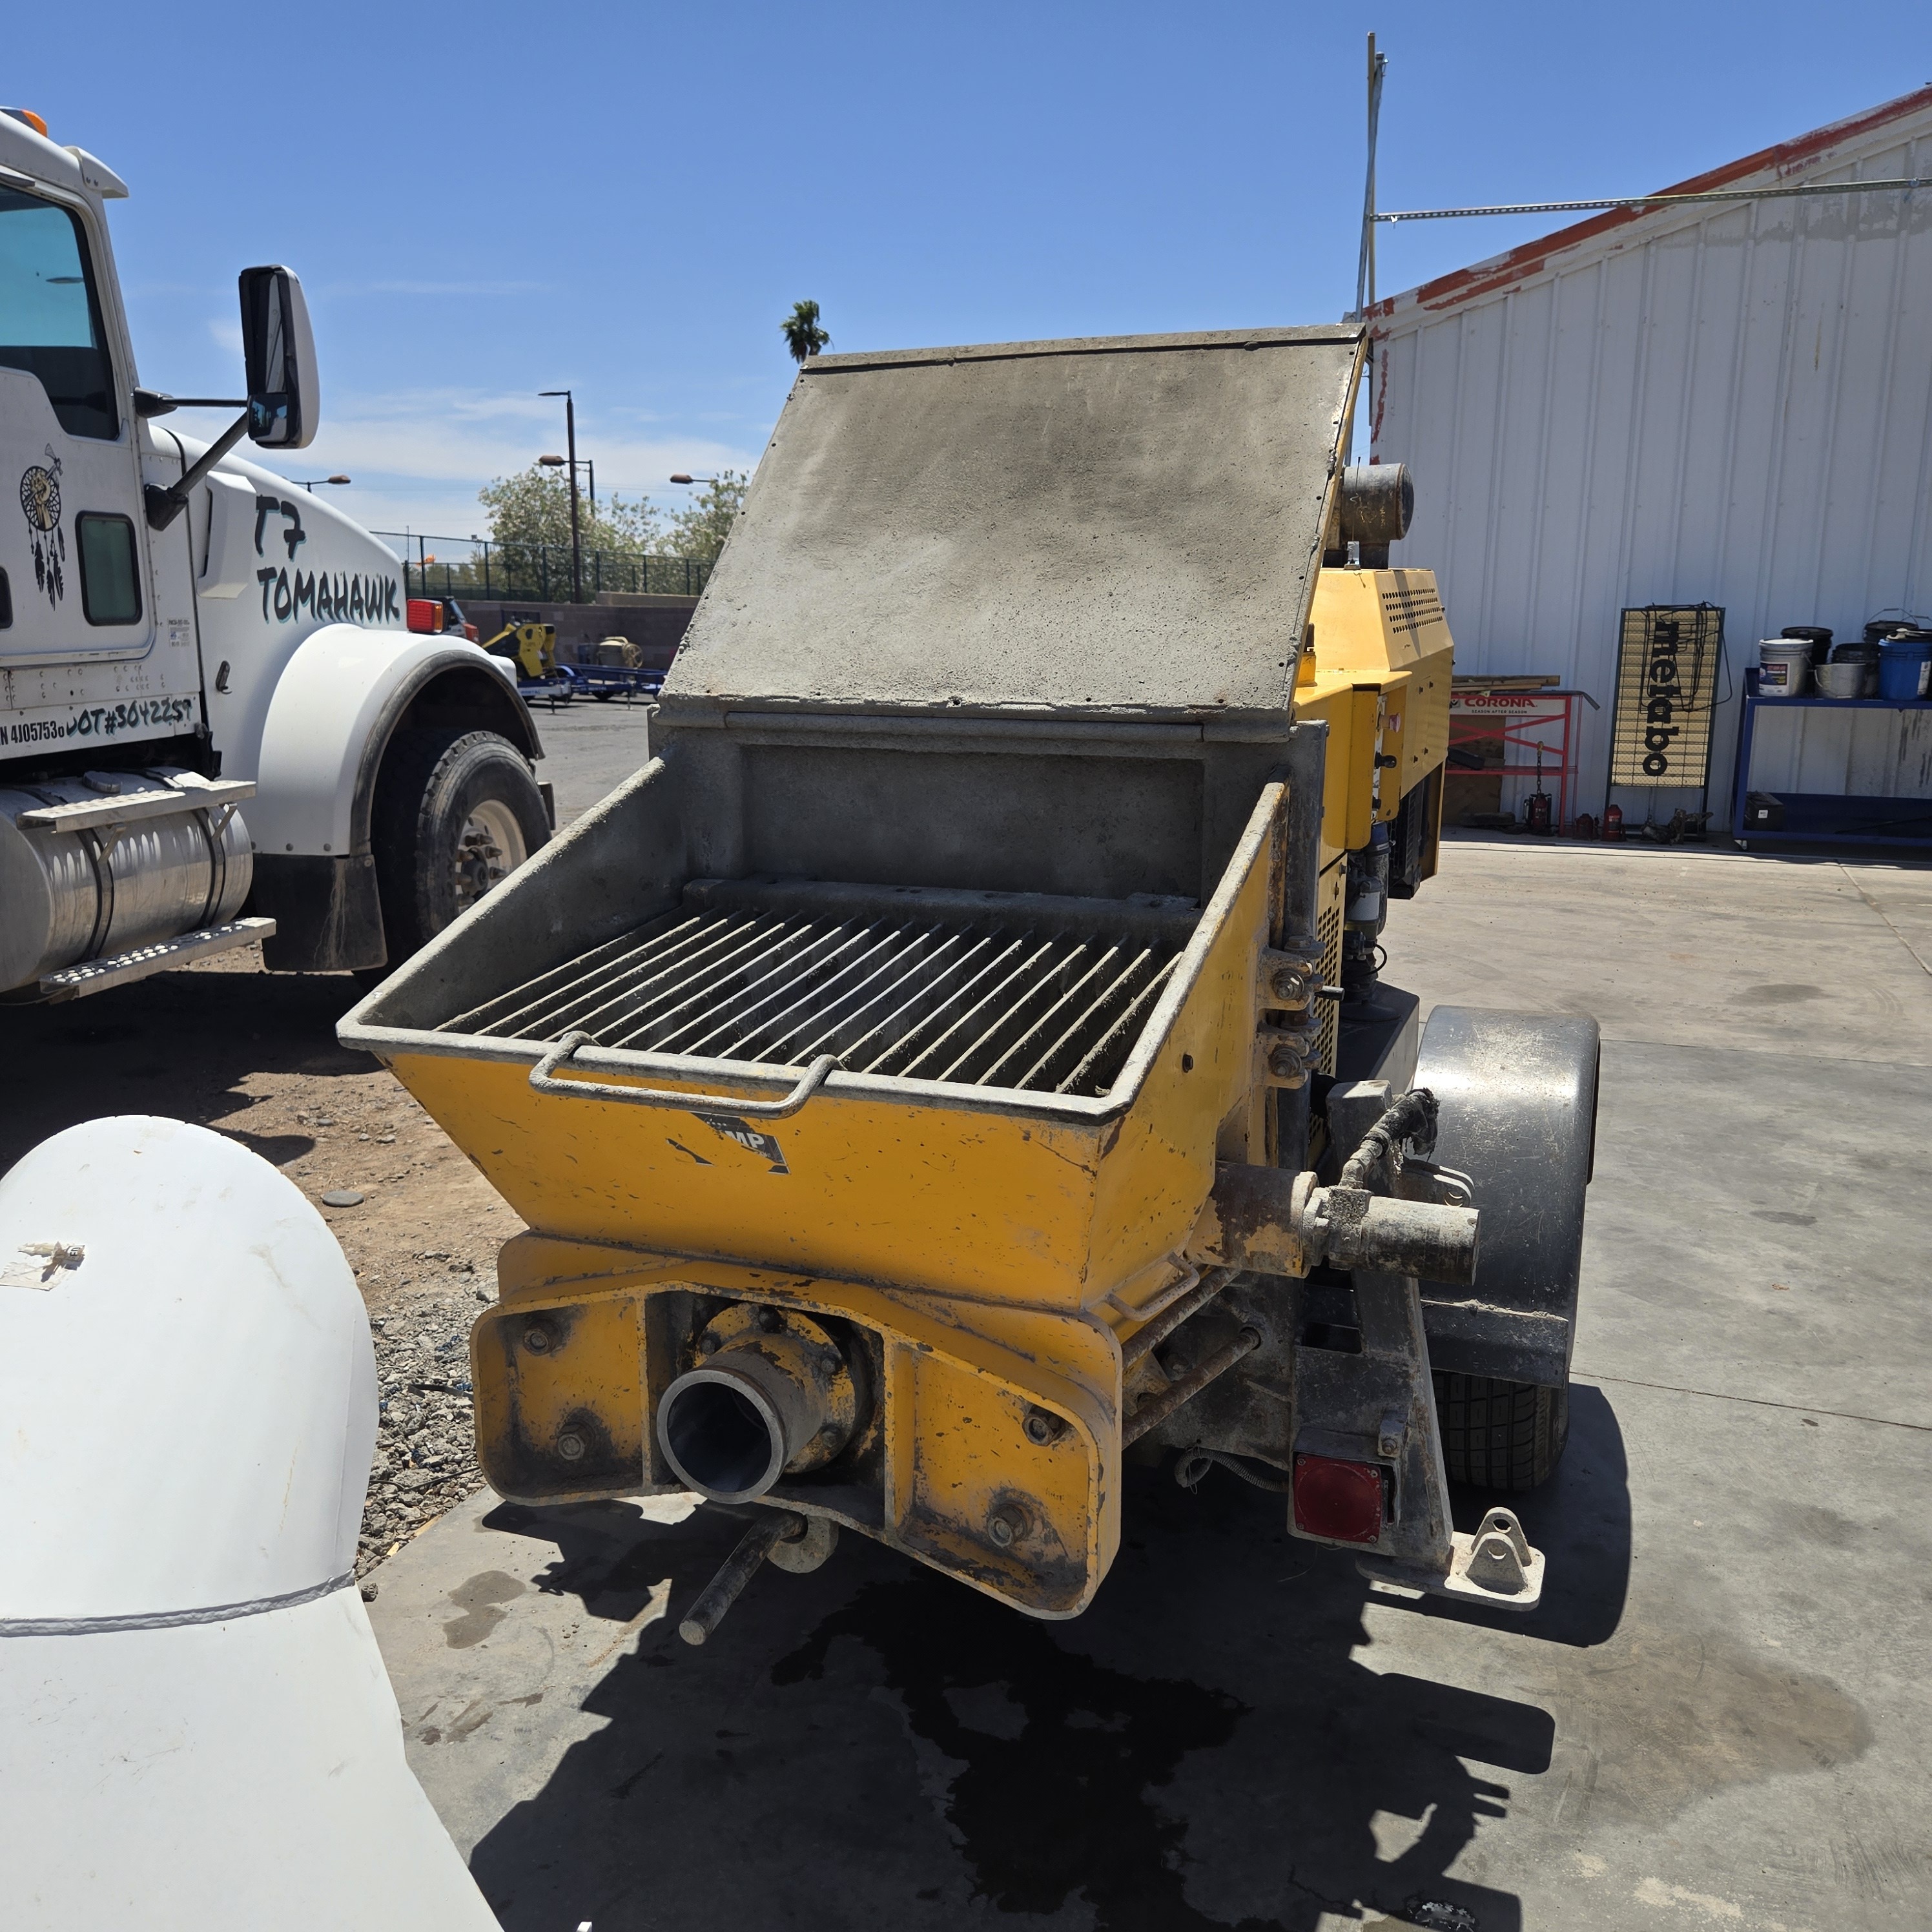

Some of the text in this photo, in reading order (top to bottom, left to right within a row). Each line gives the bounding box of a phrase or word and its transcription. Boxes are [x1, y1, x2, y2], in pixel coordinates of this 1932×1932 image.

[254, 495, 306, 561] T7
[257, 566, 400, 625] TOMAHAWK
[1464, 698, 1536, 708] CORONA
[1642, 621, 1680, 777] metabo
